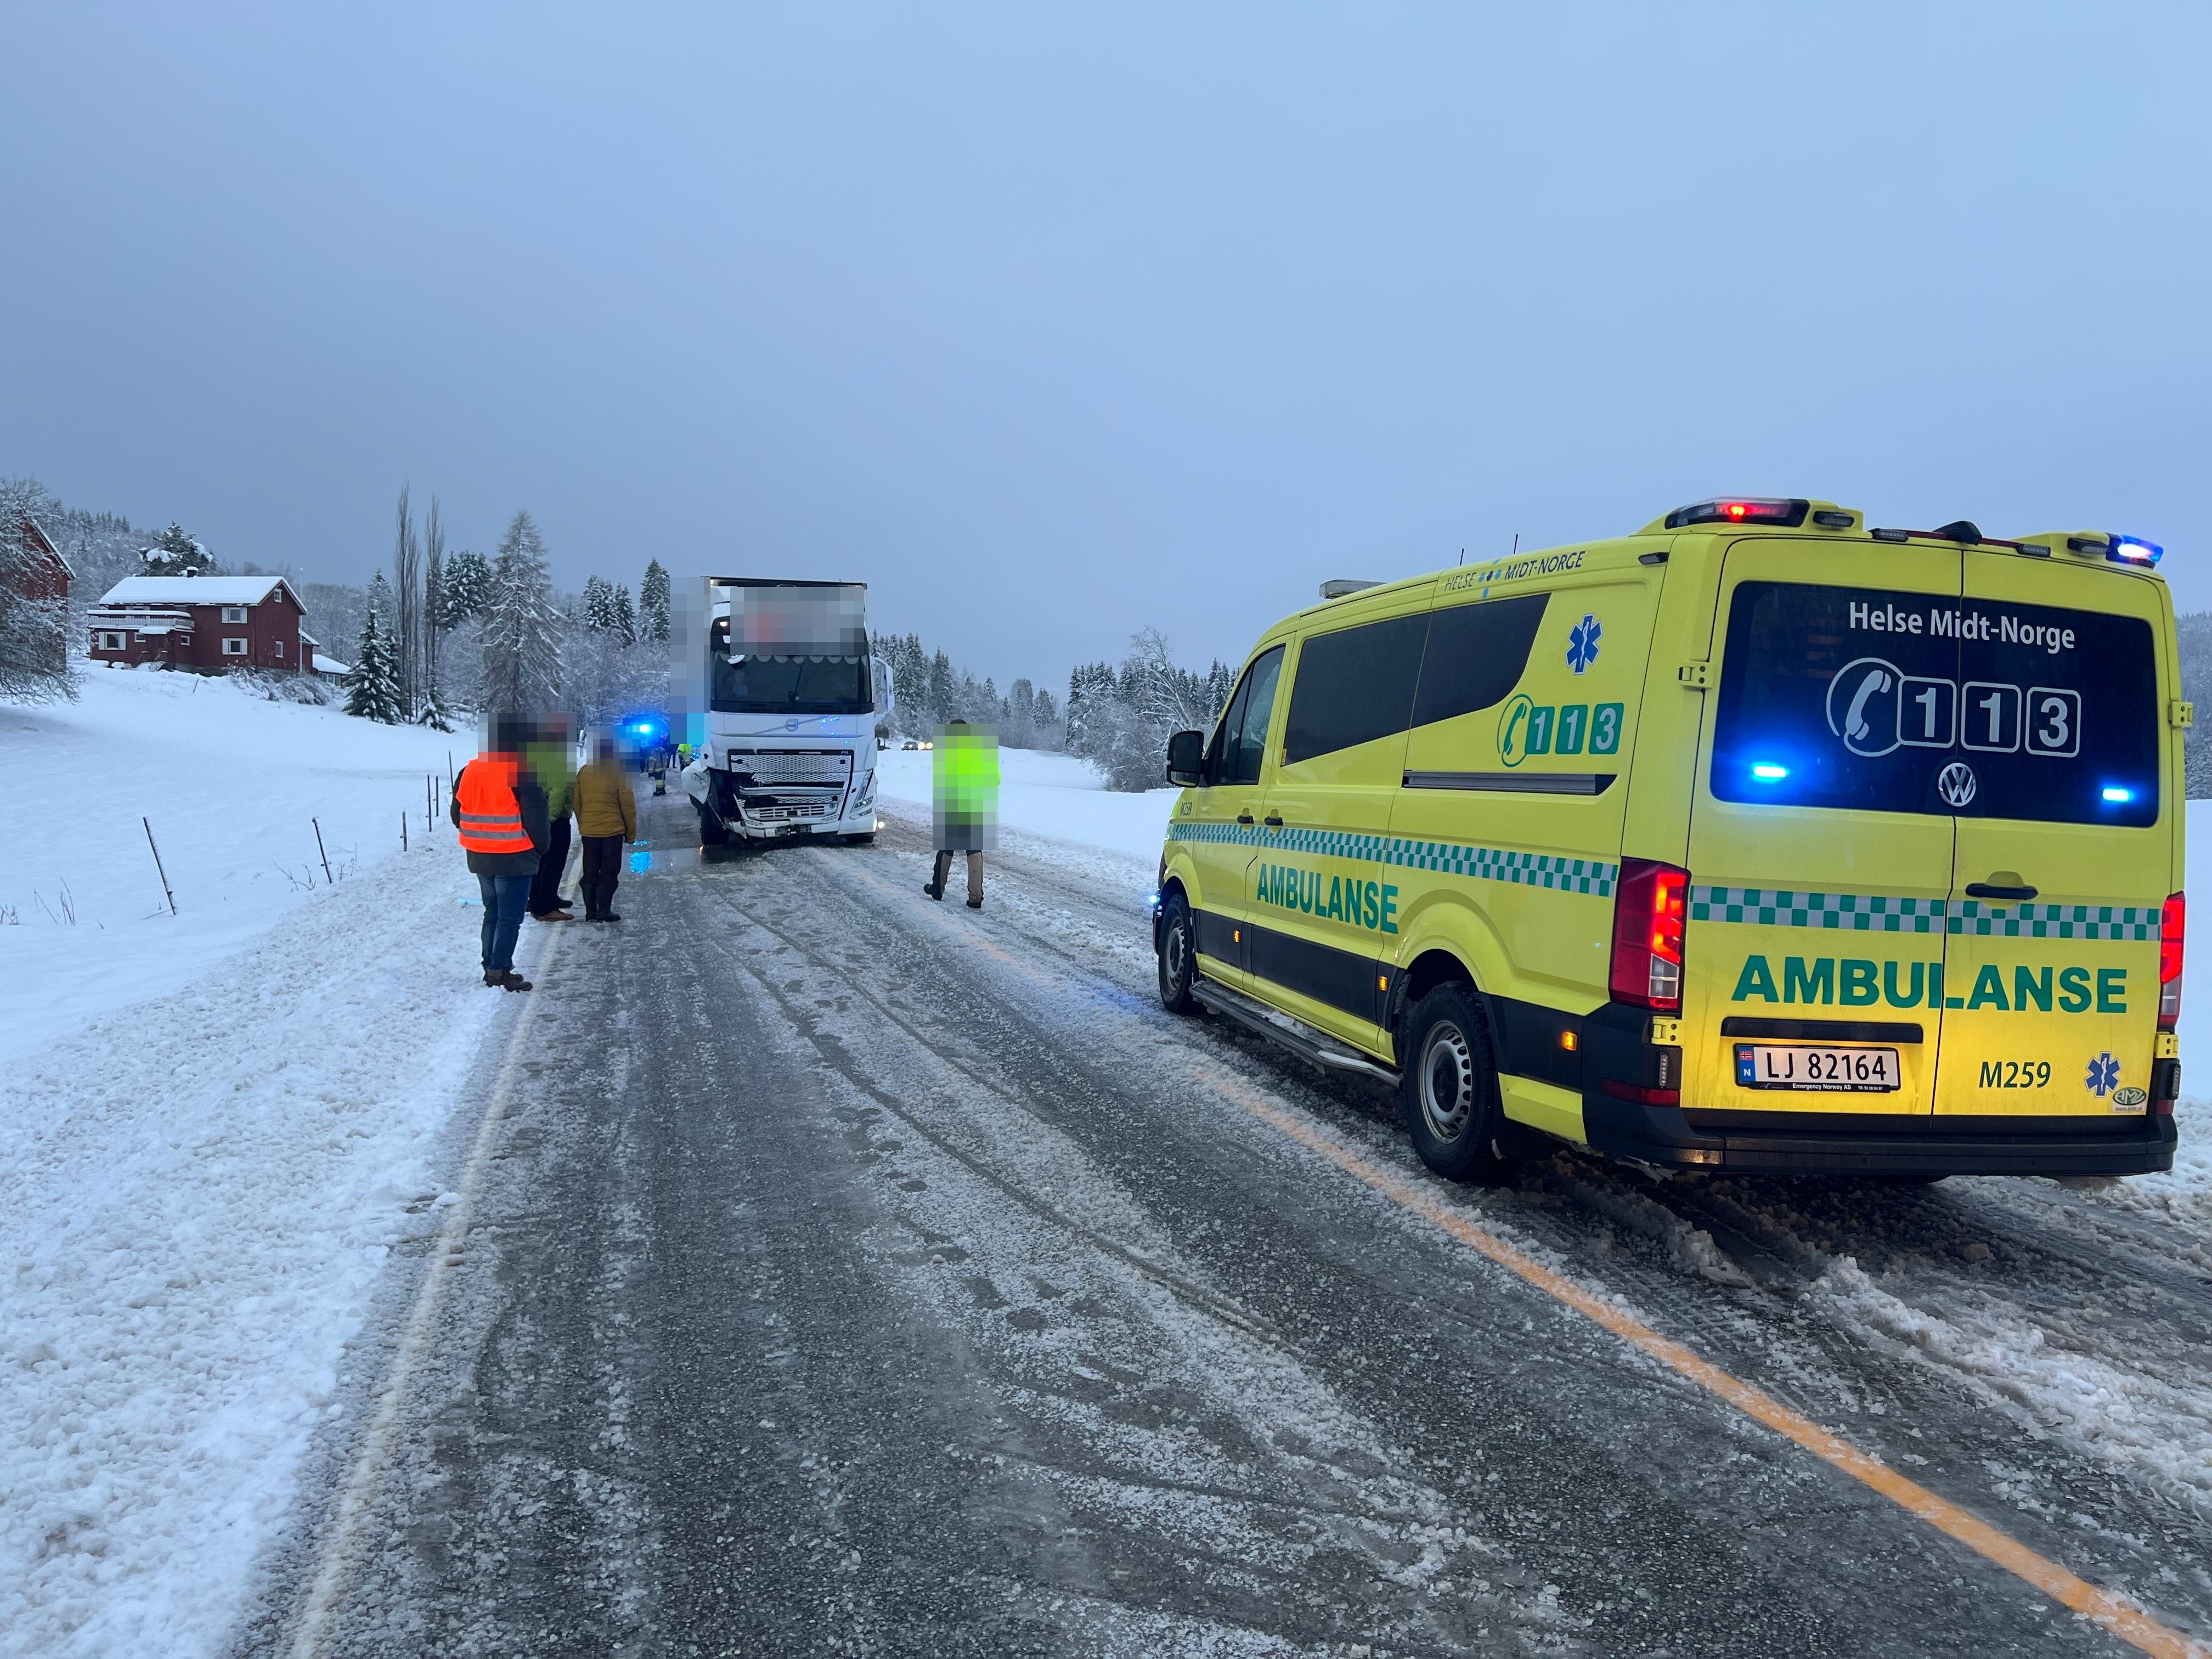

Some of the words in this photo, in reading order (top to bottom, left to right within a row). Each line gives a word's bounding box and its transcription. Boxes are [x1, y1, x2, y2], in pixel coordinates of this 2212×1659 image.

[1444, 572, 1477, 592] HELSE
[1504, 551, 1586, 581] MIDT-NORGE
[1849, 602, 1923, 634] Helse
[1929, 608, 2075, 654] Midt-Norge
[1256, 862, 1399, 934] AMBULANSE
[1731, 955, 2128, 1014] AMBULANSE
[1743, 1068, 1751, 1076] N
[1767, 1052, 1793, 1079] LJ
[1808, 1053, 1886, 1081] 82164
[1979, 1061, 2051, 1088] M259
